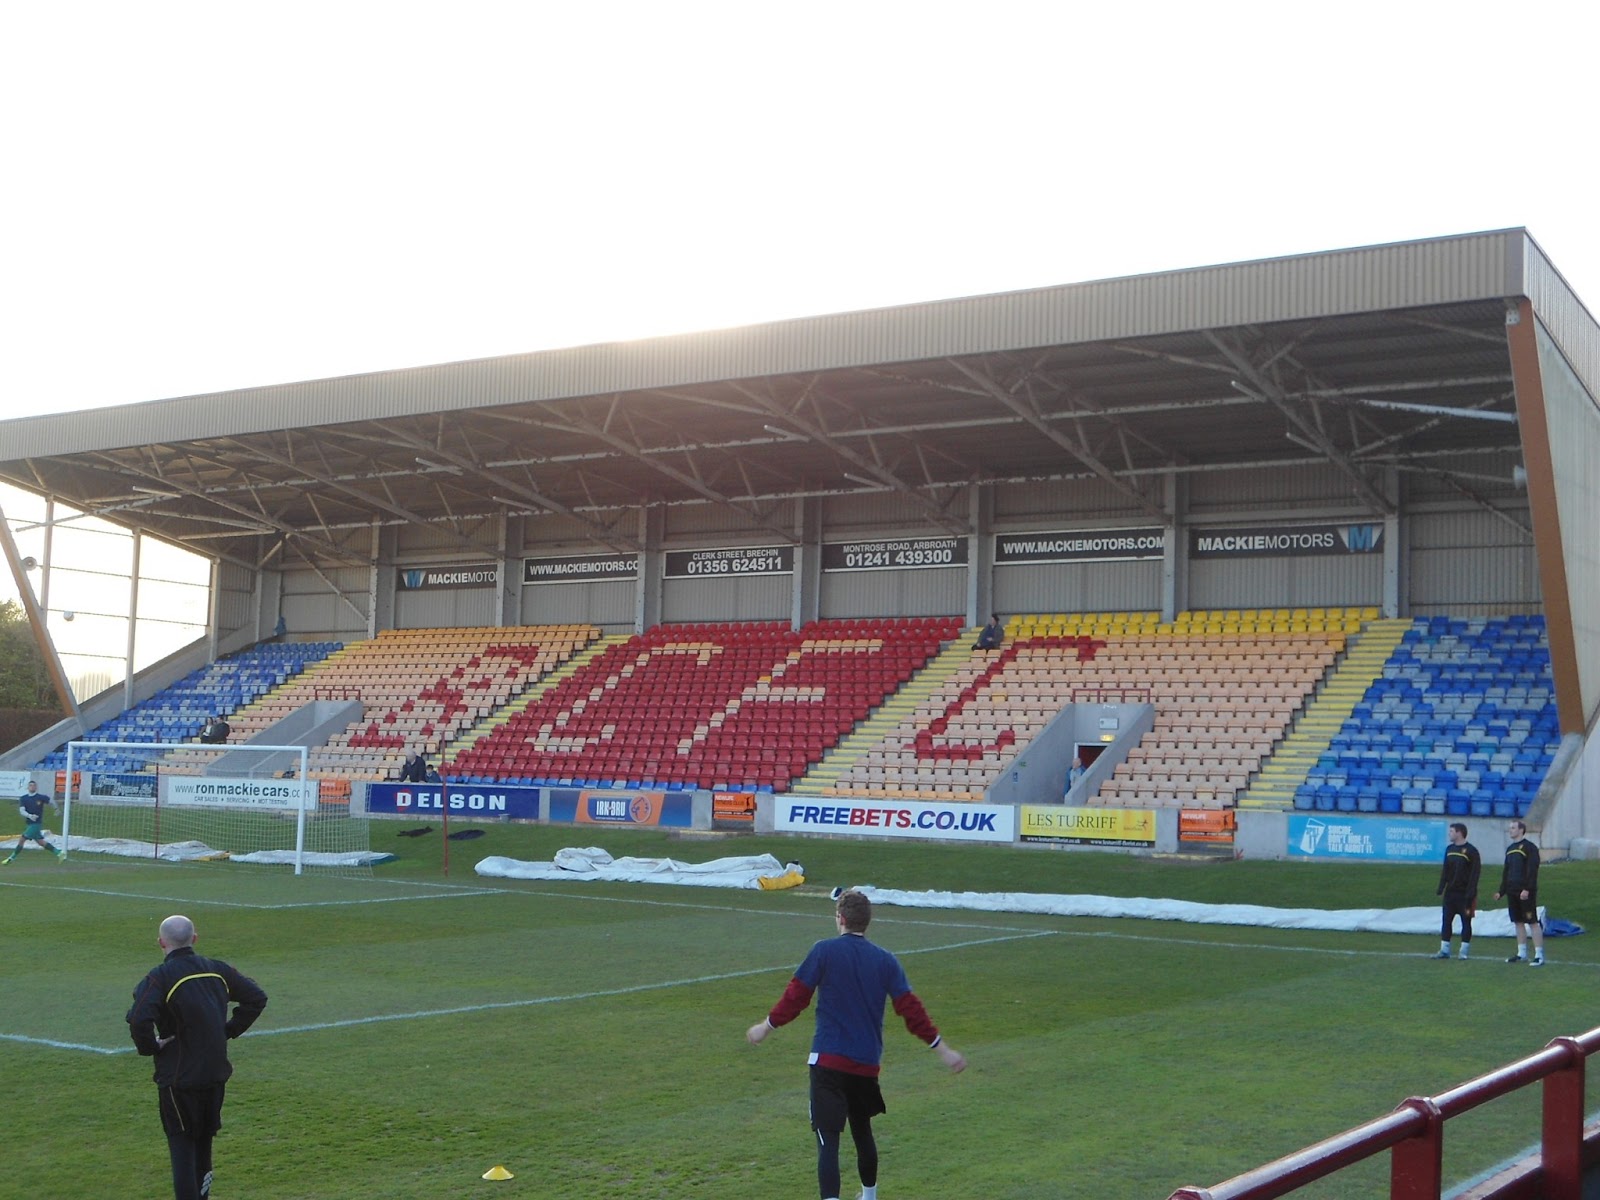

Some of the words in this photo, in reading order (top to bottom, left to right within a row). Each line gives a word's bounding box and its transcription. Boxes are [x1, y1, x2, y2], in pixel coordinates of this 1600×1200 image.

[843, 543, 886, 553] MONTROSE
[887, 541, 913, 552] ROAD,
[914, 539, 957, 550] ARBROATH
[1003, 536, 1164, 554] WWW.MACKIEMOTORS.COM
[1199, 533, 1334, 551] MACKIEMOTORS
[692, 552, 715, 560] CLERK
[747, 548, 779, 558] BRECHIN
[846, 552, 890, 567] 01241
[895, 549, 952, 565] 439300
[530, 560, 638, 576] WWW.MACKIEMOTORS.CO
[687, 560, 729, 574] 01356
[732, 557, 782, 572] 624511
[428, 570, 498, 585] MACKIEMOTO
[397, 792, 506, 810] DELSON
[789, 805, 997, 832] FREEBETS.CO.UK
[1028, 813, 1053, 826] LES
[1056, 815, 1117, 829] TURRIFF
